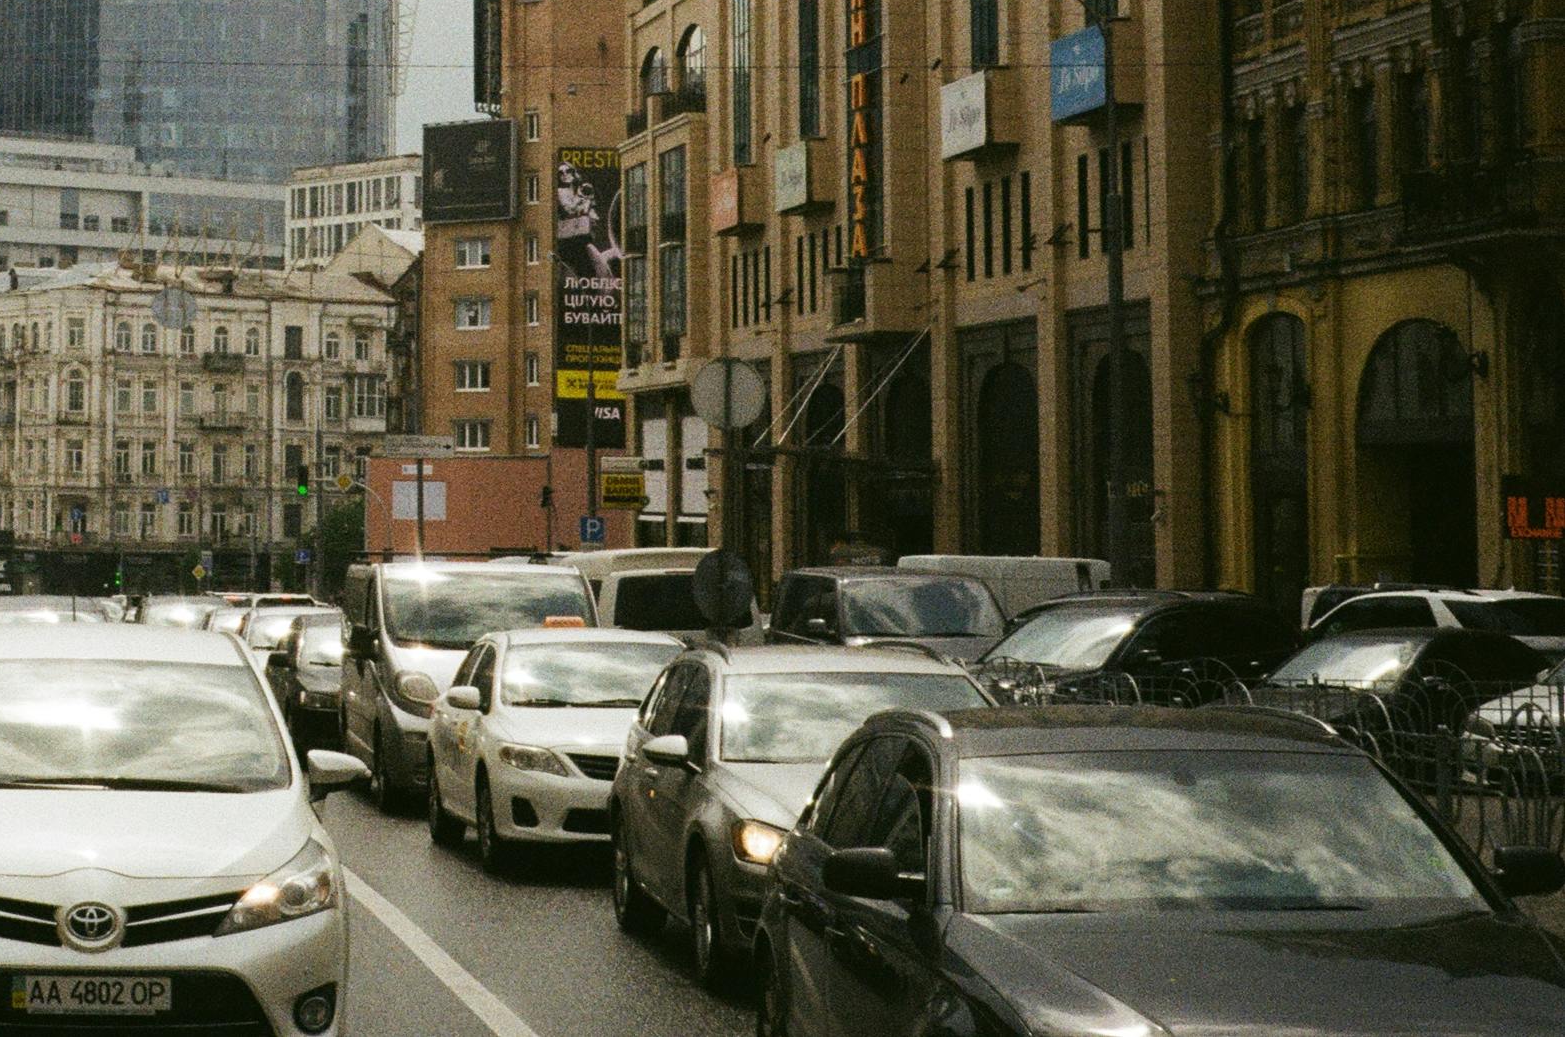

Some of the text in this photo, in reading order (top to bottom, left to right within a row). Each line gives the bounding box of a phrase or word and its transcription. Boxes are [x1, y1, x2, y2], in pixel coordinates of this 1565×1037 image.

[851, 73, 867, 258] ПЛАЗА
[586, 518, 601, 539] P
[29, 980, 166, 1006] AA 4802 OP
